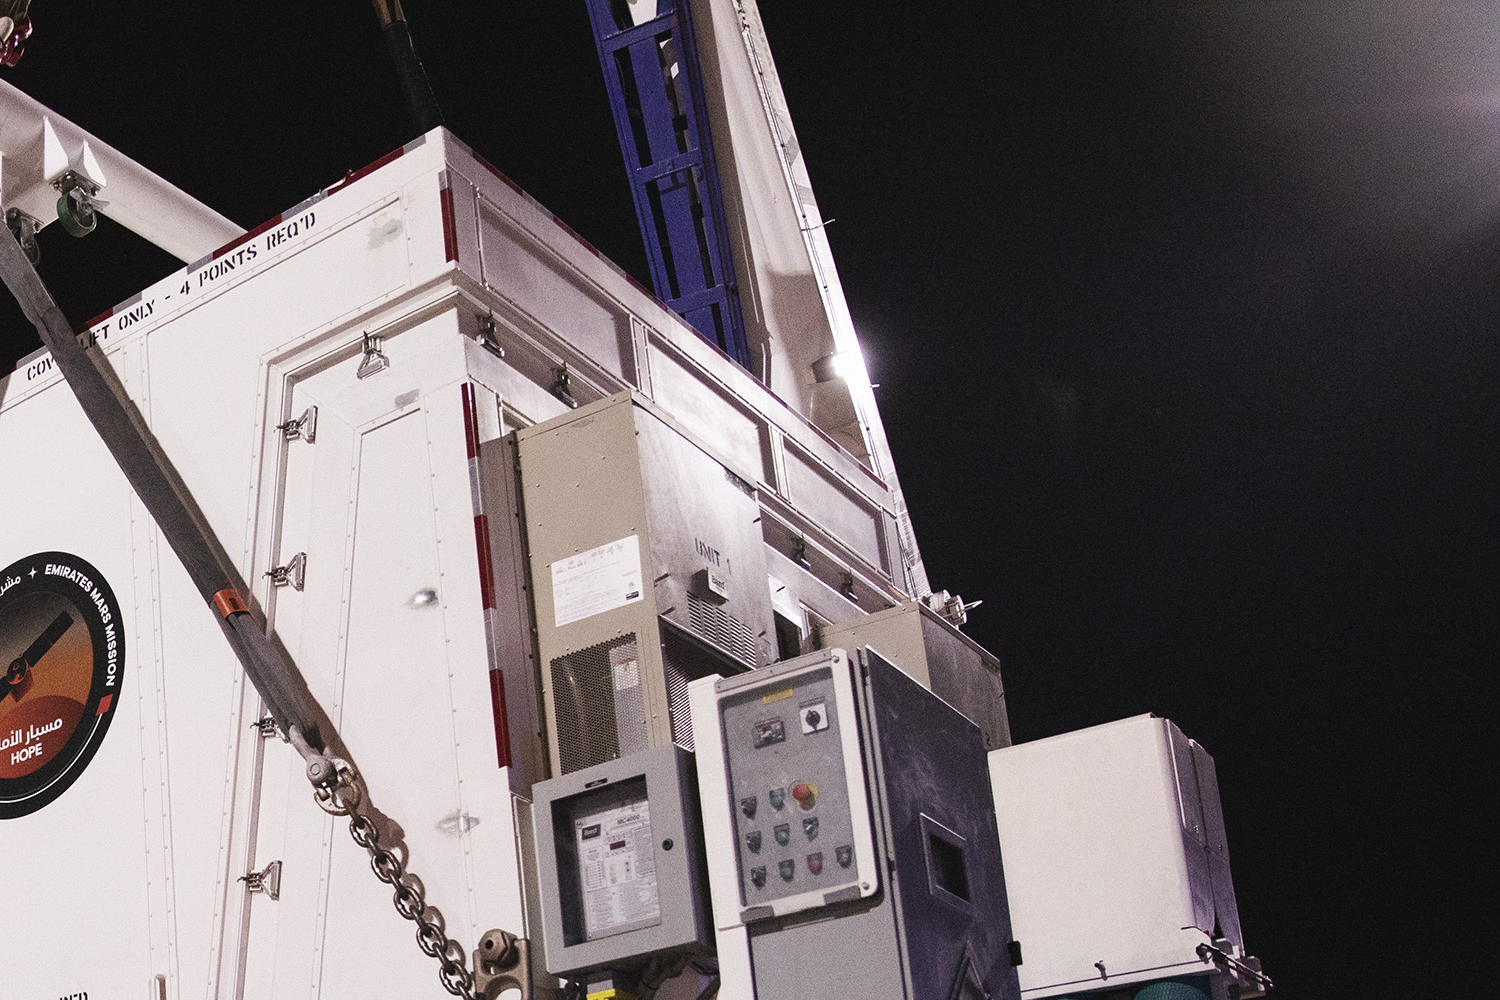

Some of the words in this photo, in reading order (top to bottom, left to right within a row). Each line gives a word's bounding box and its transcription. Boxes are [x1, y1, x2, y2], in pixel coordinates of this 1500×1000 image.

[27, 356, 59, 381] COV
[80, 324, 110, 350] LIFT
[118, 299, 155, 331] ONLY
[180, 281, 191, 296] 4
[199, 244, 257, 287] POINTS
[266, 211, 316, 251] REQ'D
[695, 538, 720, 567] UNIT
[45, 564, 93, 593] EMIRATES
[89, 588, 111, 625] MARS
[104, 624, 117, 686] MISSION
[25, 717, 63, 746] مسبار
[10, 743, 43, 766] HOPE
